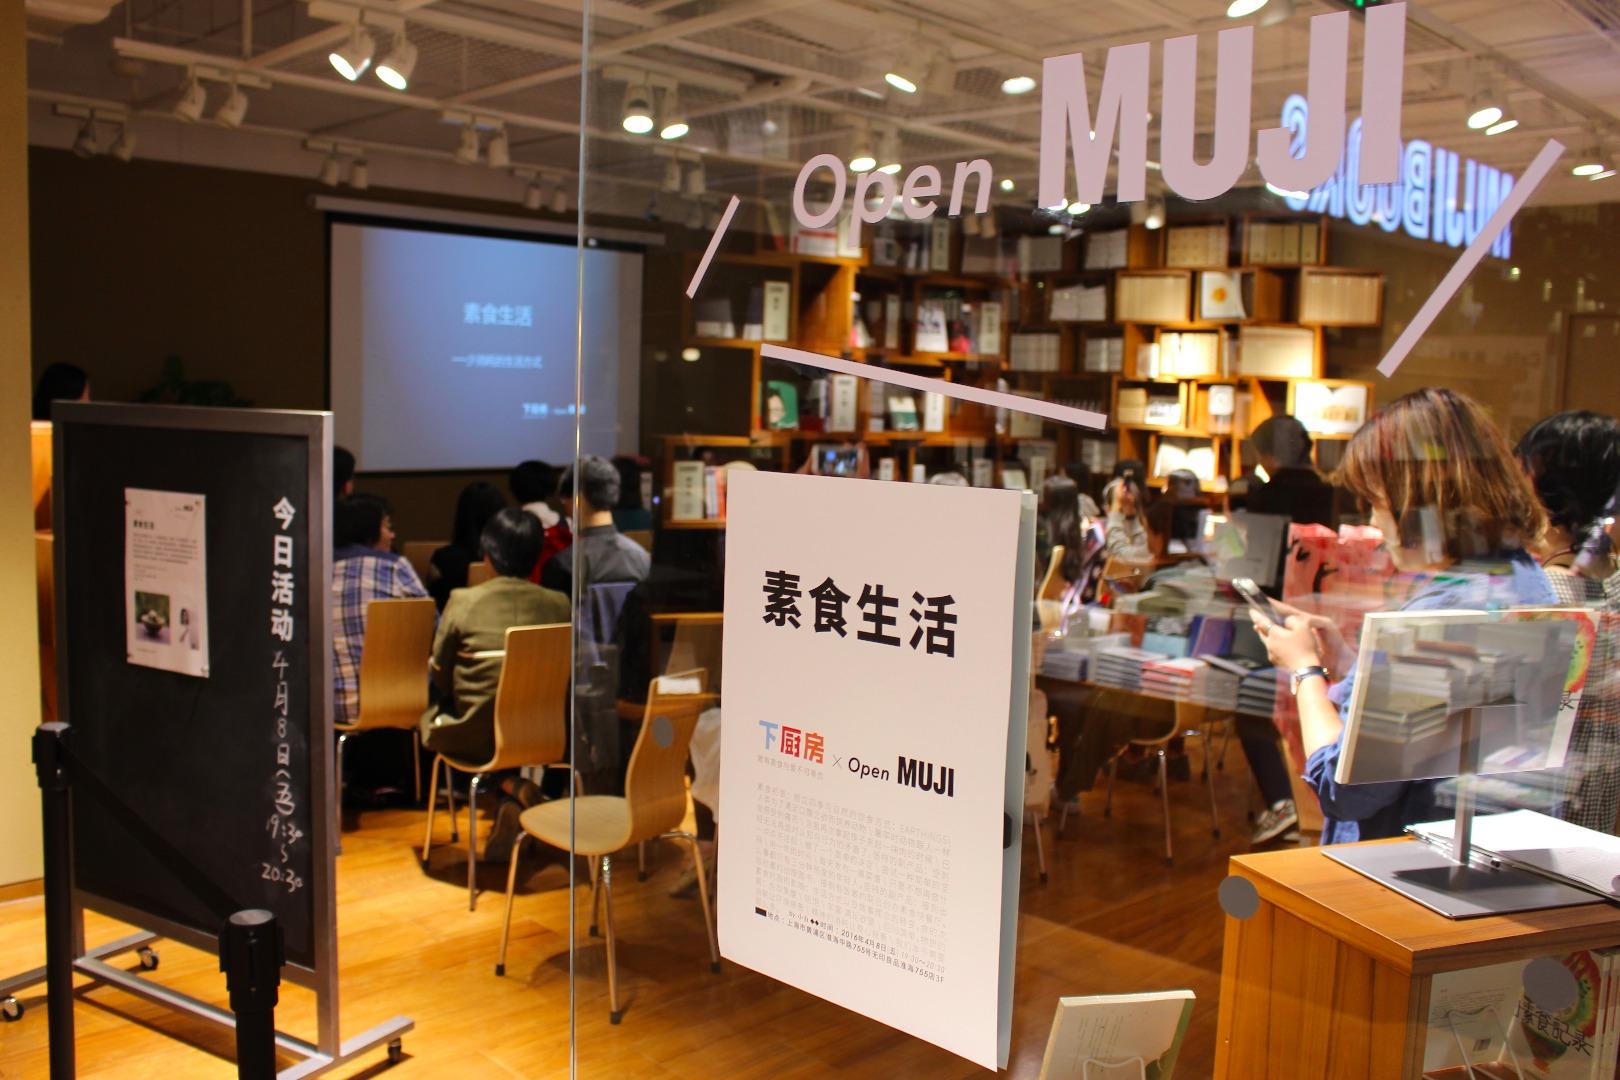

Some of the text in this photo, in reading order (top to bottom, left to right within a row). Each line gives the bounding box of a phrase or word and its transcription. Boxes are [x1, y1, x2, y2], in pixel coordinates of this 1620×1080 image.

[793, 2, 1407, 246] Open MUJI
[271, 496, 297, 643] 今日活动
[761, 570, 958, 659] 素食生活
[758, 719, 825, 765] 下厨房
[848, 757, 891, 782] Open
[897, 755, 956, 798] MUJI
